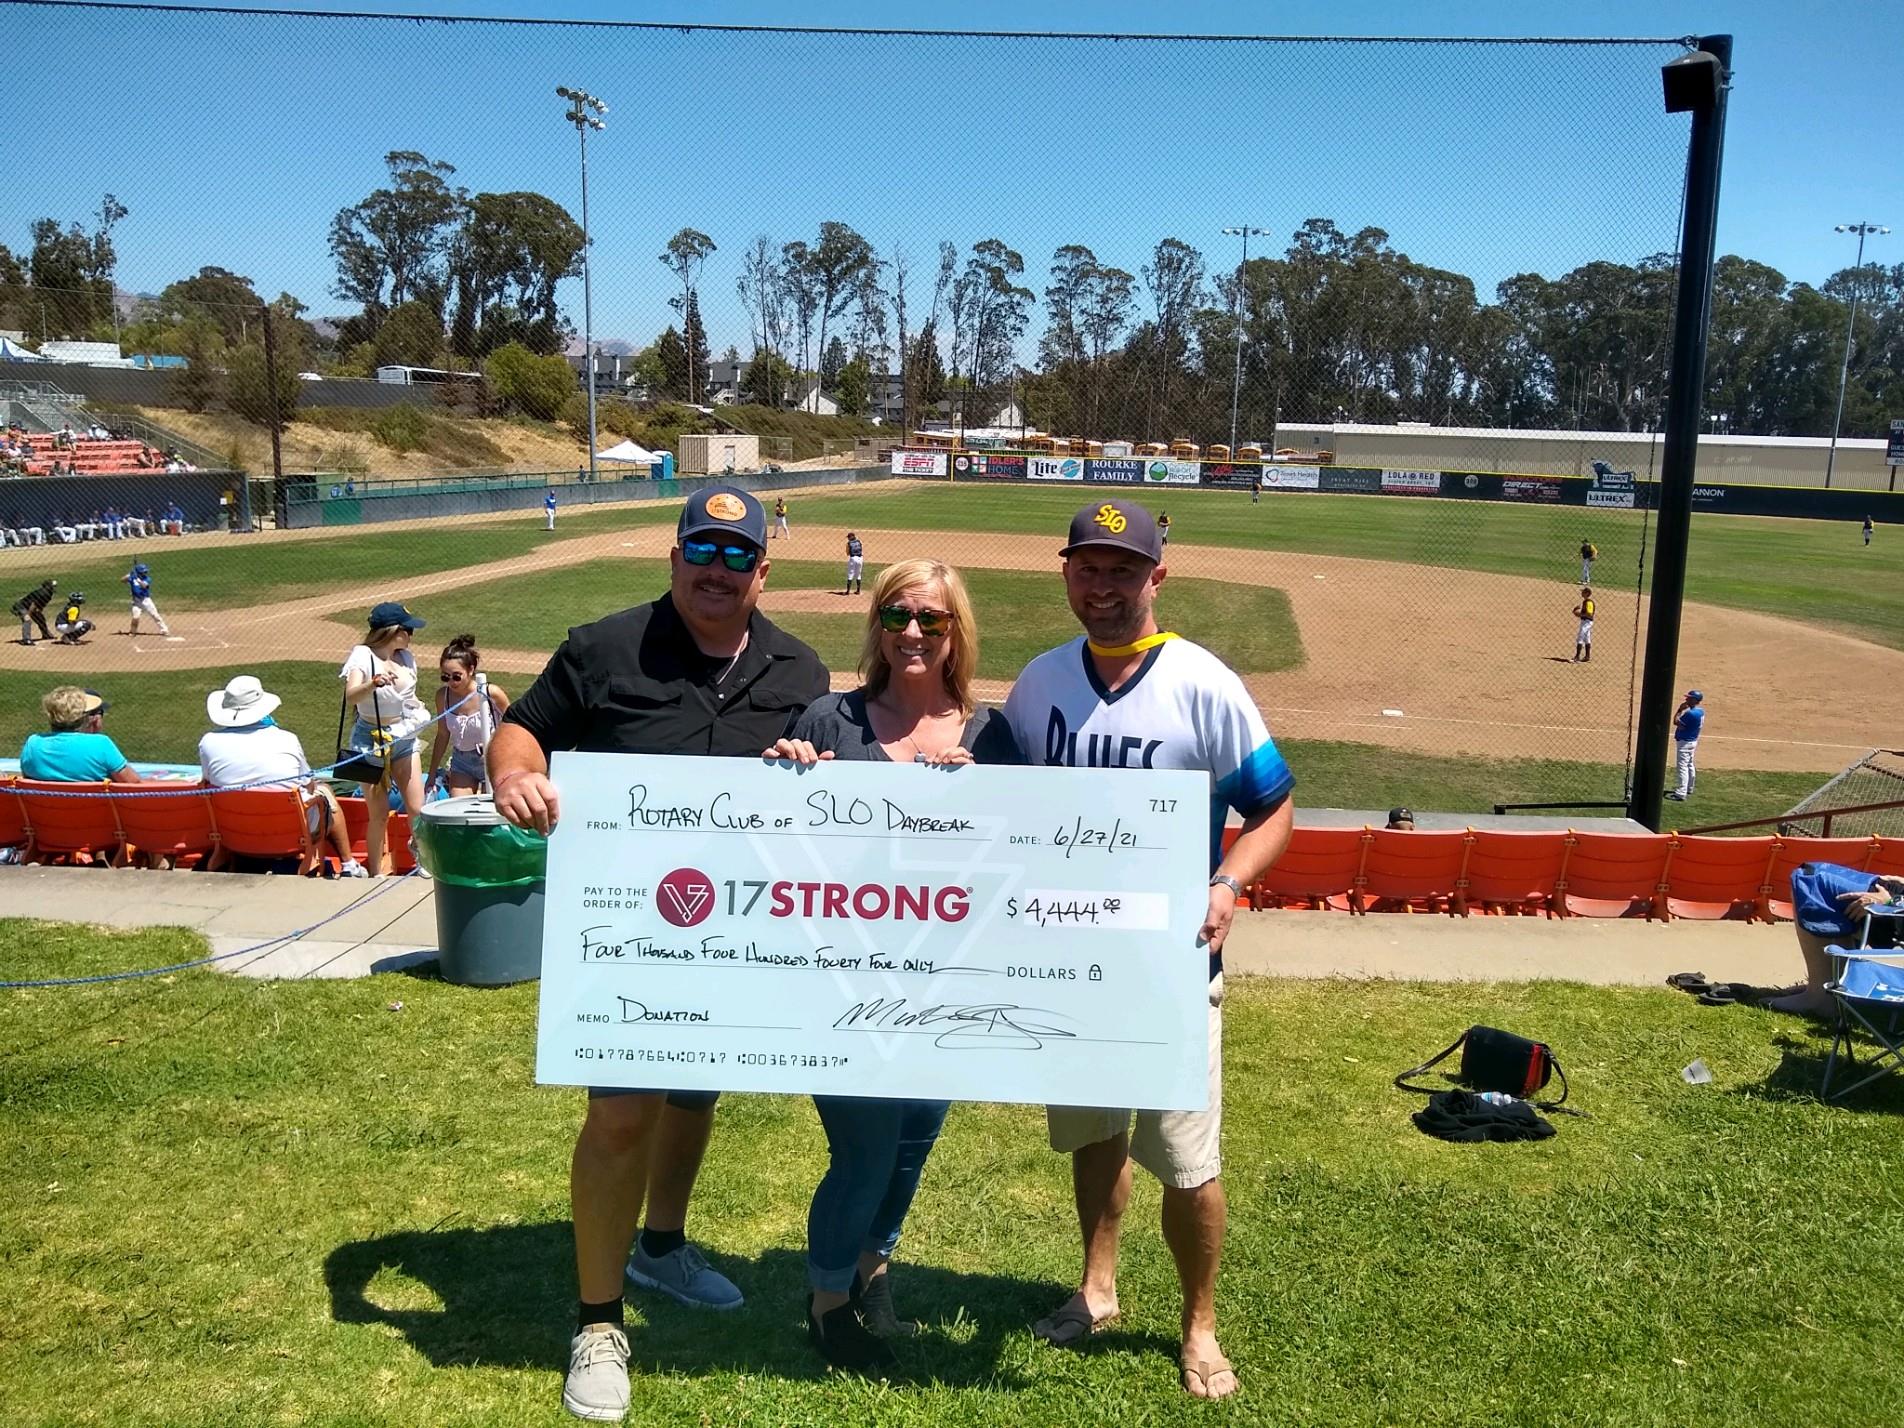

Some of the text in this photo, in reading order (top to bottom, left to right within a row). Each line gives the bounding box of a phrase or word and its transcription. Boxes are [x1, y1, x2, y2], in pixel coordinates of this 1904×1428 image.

[904, 457, 934, 467] ESPN
[988, 457, 1025, 466] IDLER'S
[1092, 460, 1138, 470] ROURKE
[988, 465, 1020, 474] HOME
[1035, 461, 1057, 477] Lite
[1093, 471, 1135, 481] FAMILY
[1388, 471, 1407, 479] LOLA
[1692, 488, 1725, 497] ANNON
[1588, 494, 1626, 503] ULTREX
[1094, 504, 1128, 534] SLO
[628, 784, 703, 828] ROTARY
[806, 790, 873, 826] SLO
[881, 797, 975, 832] DAYBREAK
[1149, 799, 1178, 812] 717
[586, 821, 623, 831] FROM:
[1009, 835, 1042, 845] DATE:
[1053, 815, 1137, 859] 6/27/21
[584, 887, 648, 897] PAY TO THE
[583, 899, 644, 910] ORDER OF:
[1007, 966, 1077, 980] DOLLARS
[616, 995, 710, 1023] DONATION
[576, 1013, 610, 1023] MEMO
